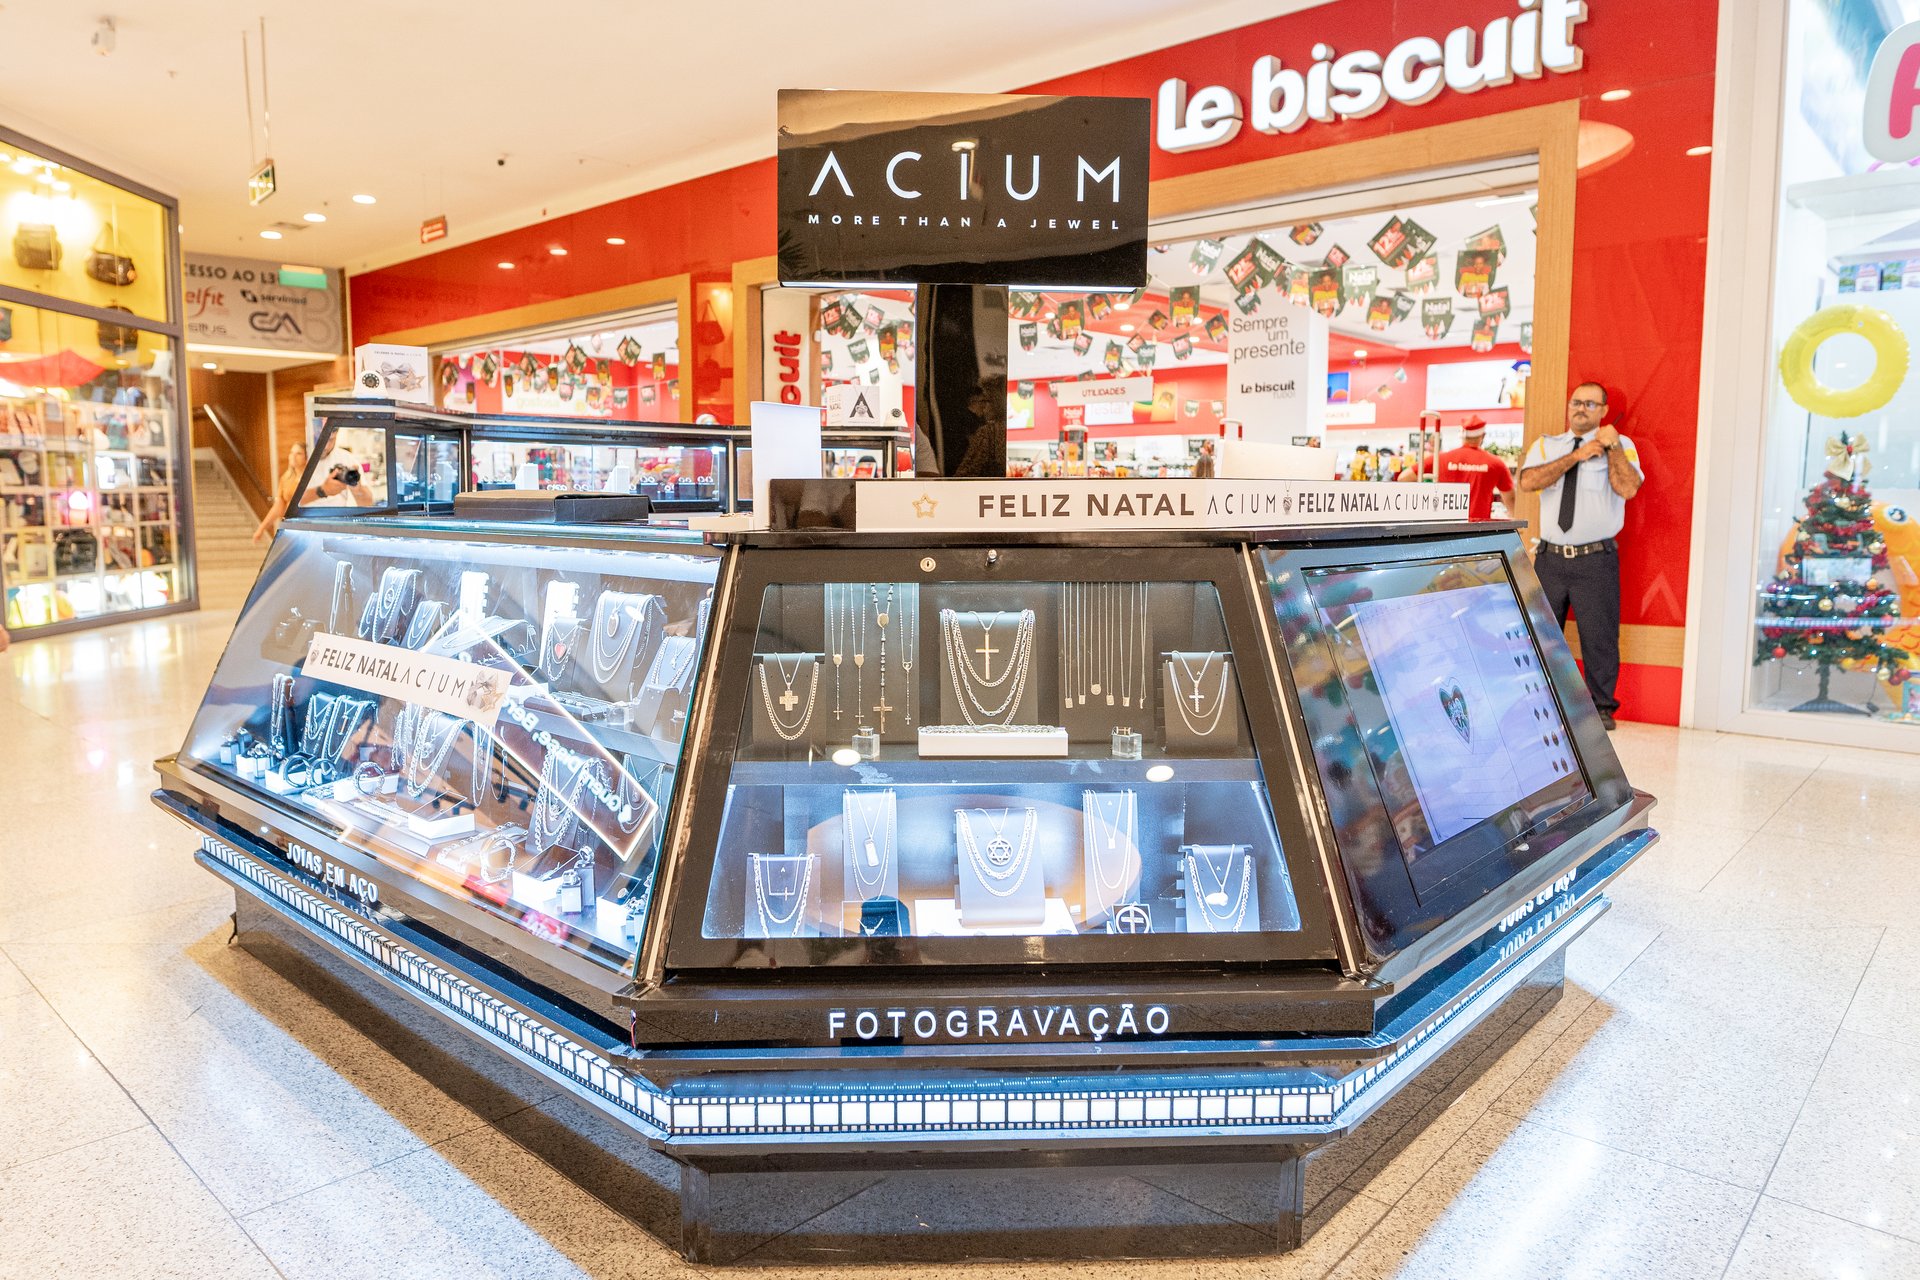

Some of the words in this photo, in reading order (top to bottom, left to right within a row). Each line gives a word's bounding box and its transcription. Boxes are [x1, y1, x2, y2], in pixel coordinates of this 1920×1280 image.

[1157, 77, 1243, 154] Le
[1252, 0, 1588, 135] biscuit
[808, 150, 1121, 203] ACIUM
[808, 214, 881, 226] MORE
[899, 215, 972, 228] THAN
[997, 218, 1007, 229] A
[1030, 219, 1119, 231] JEWEL
[184, 262, 226, 280] ESSO
[232, 269, 255, 283] AO
[1233, 316, 1289, 334] Sempre
[1268, 330, 1289, 342] um
[1234, 339, 1306, 364] presente
[1082, 387, 1126, 397] UTILIDADES
[1241, 383, 1253, 394] Le
[1255, 380, 1295, 393] biscuit
[978, 494, 1071, 518] FELIZ
[1087, 493, 1195, 517] NATAL
[1207, 493, 1276, 515] ACIUM
[1298, 493, 1335, 513] FELIZ
[1340, 492, 1379, 513] NATAL
[1442, 493, 1469, 511] FELIZ
[320, 647, 356, 672] FELIZ
[357, 655, 399, 682] NATAL
[401, 667, 467, 698] ACIUM
[286, 842, 323, 875] JOIAS
[325, 862, 346, 888] EM
[349, 873, 379, 904] AÇO
[829, 1003, 1170, 1042] FOTOGRAVAÇÃO
